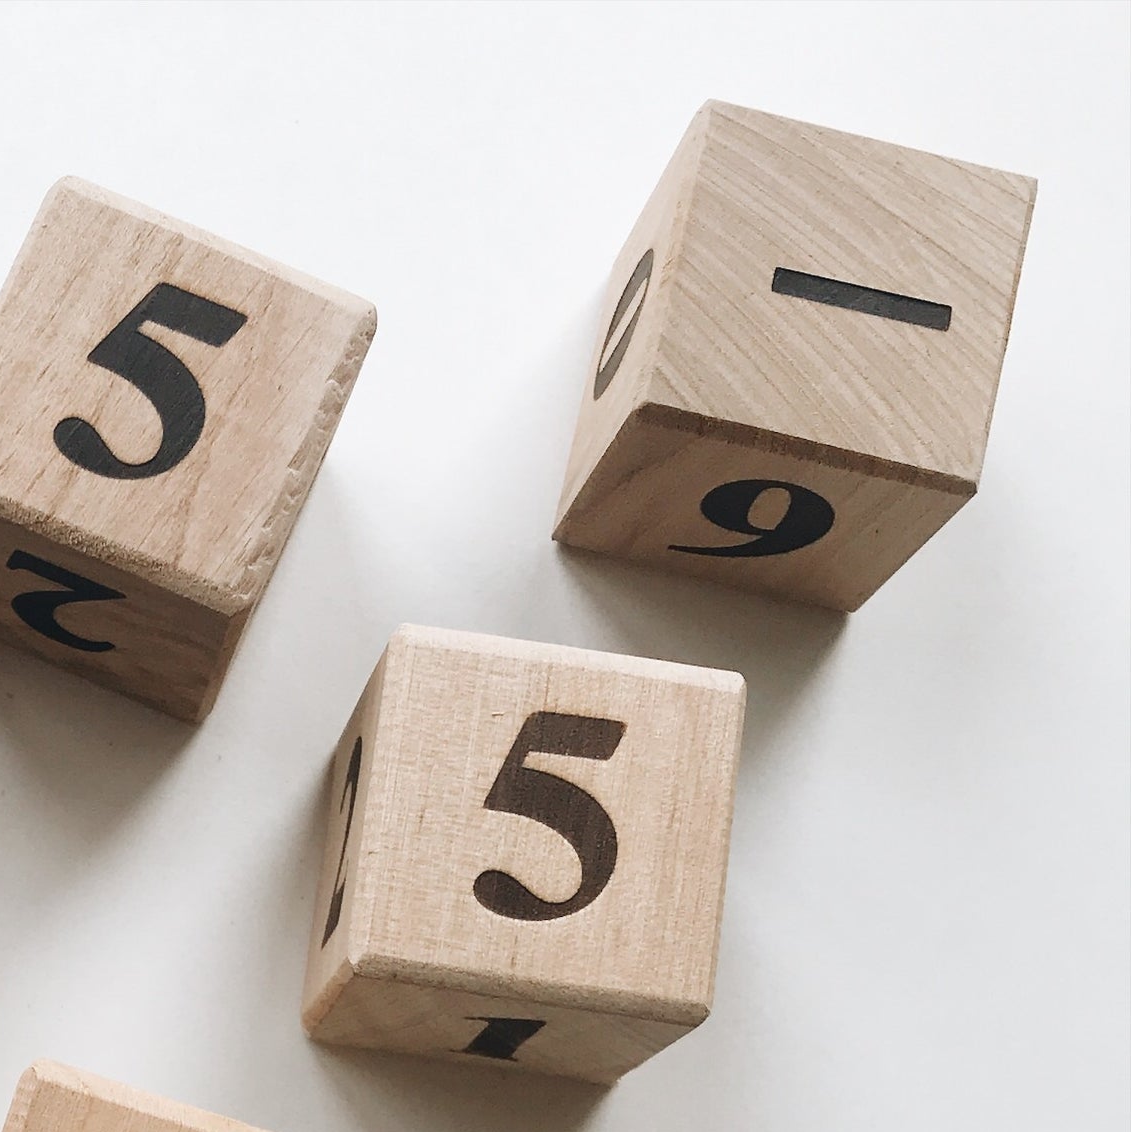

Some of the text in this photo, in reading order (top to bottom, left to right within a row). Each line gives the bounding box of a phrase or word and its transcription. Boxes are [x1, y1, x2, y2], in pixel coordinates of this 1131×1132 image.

[53, 283, 247, 480] 5
[593, 248, 654, 401] 0
[6, 550, 126, 652] 2
[473, 711, 626, 921] 5
[448, 1017, 547, 1062] 1
